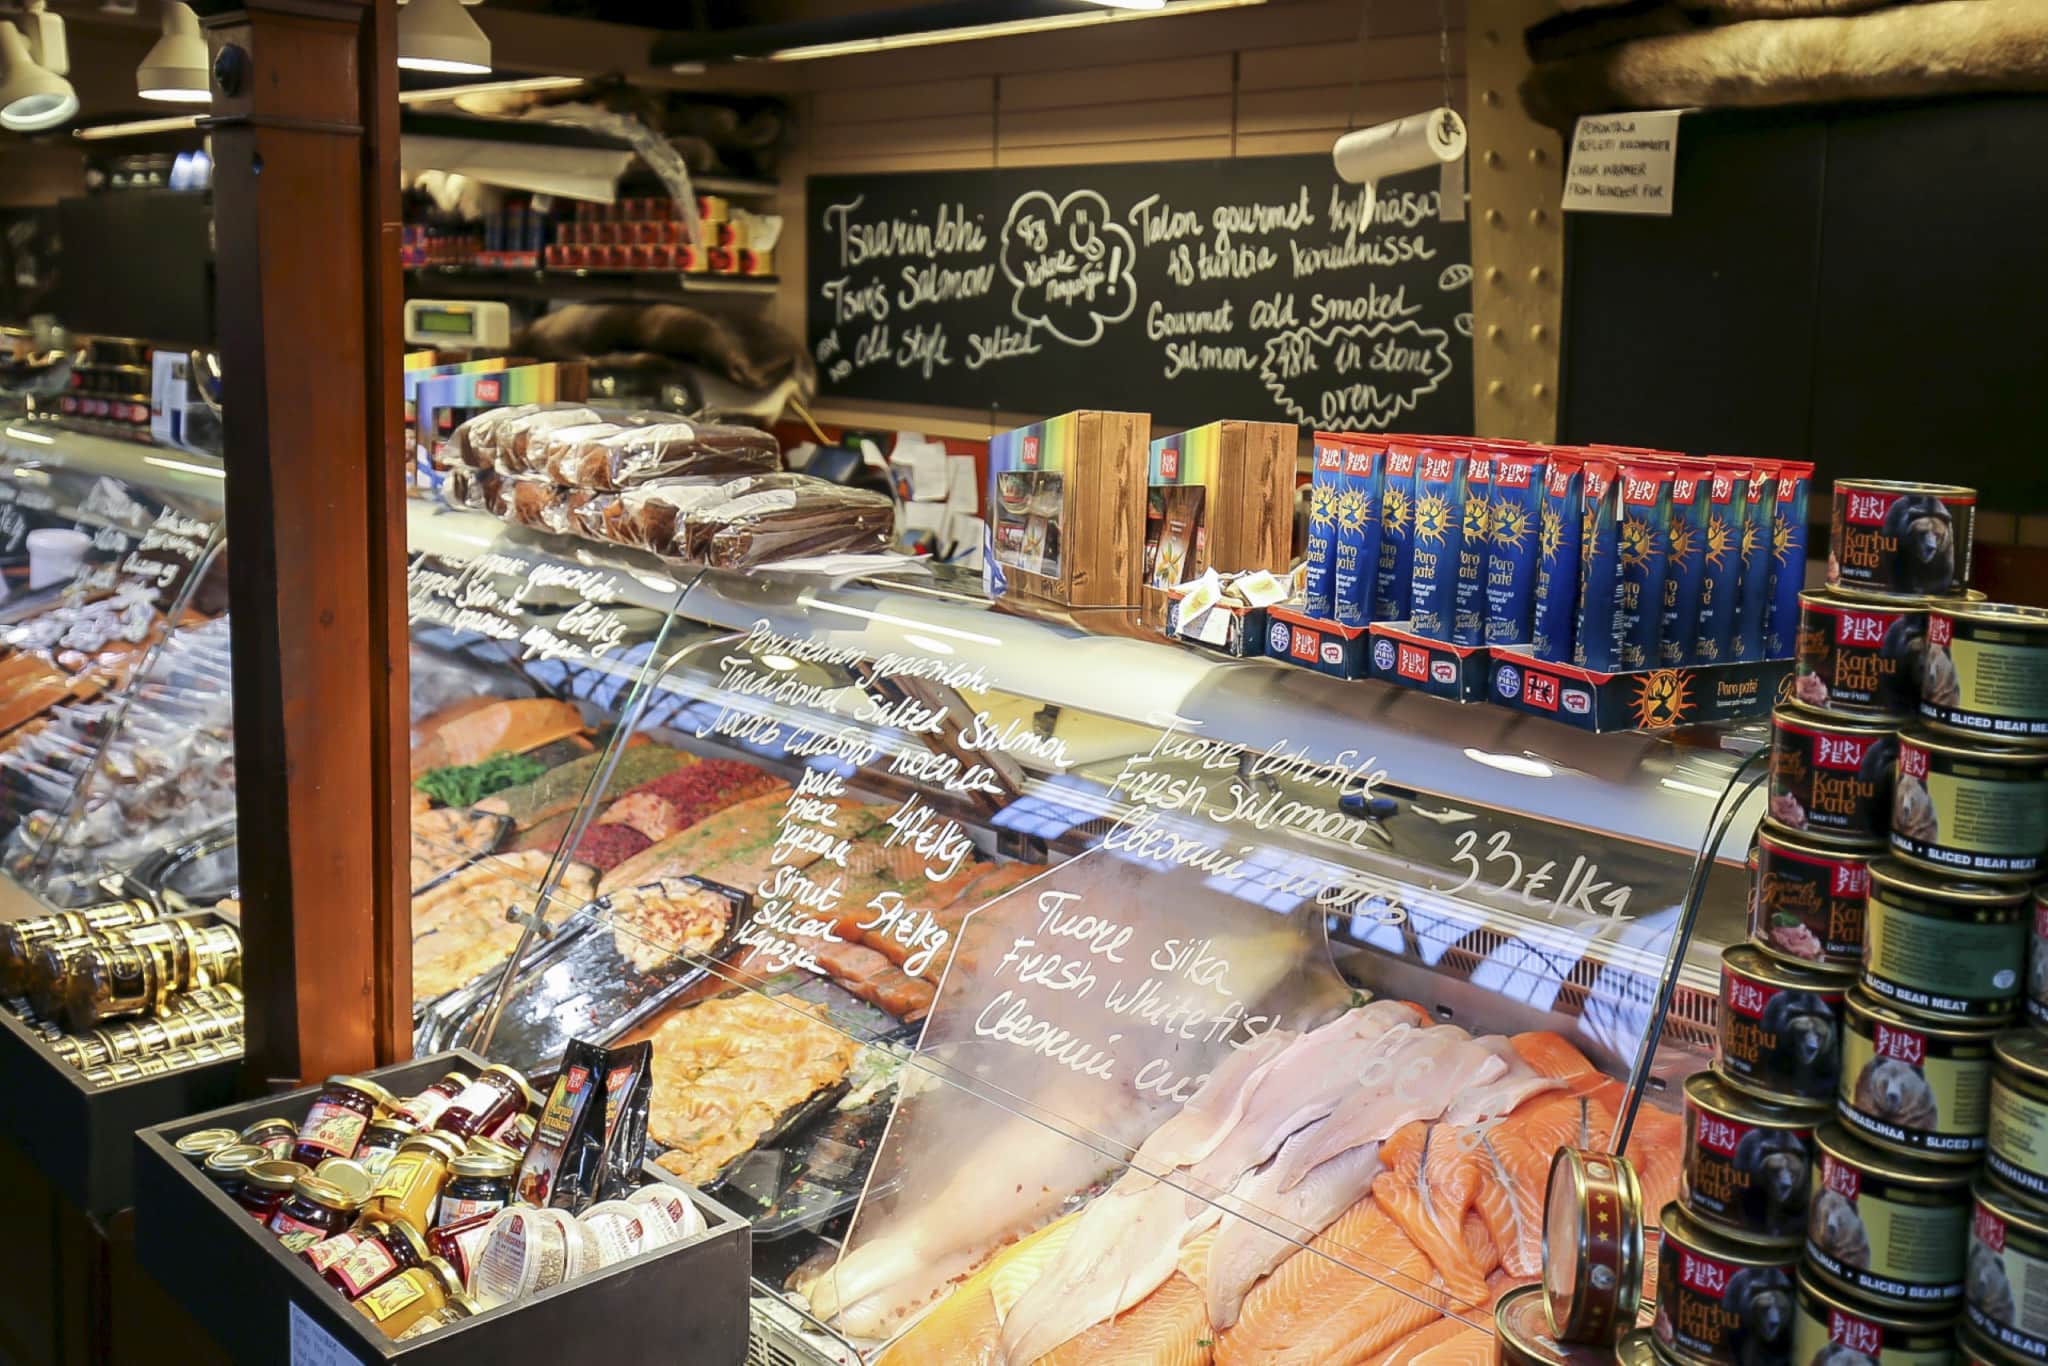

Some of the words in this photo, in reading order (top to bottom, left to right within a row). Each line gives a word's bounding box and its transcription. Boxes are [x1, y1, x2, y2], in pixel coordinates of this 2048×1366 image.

[1846, 527, 1898, 552] Karhu
[1835, 648, 1897, 673] Karhu
[854, 694, 946, 735] Salted
[957, 712, 1075, 769] Salmon
[1147, 711, 1249, 770] Tuore
[1950, 713, 1991, 728] SLICED
[1994, 719, 2028, 732] BEAR
[1105, 753, 1208, 817] Fresh
[1208, 784, 1369, 850] Salmon
[1813, 769, 1875, 797] Karhu
[776, 798, 839, 828] piece
[1928, 847, 1971, 865] SLICED
[1974, 856, 2007, 869] BEAR
[1429, 830, 1637, 938] 33€/kg
[753, 900, 844, 943] Sliced
[1037, 890, 1136, 964] Tuore
[993, 935, 1097, 999] Fresh
[1866, 973, 1894, 995] SLICED
[1896, 989, 1929, 1005] BEAR
[1932, 997, 1968, 1013] MEAT
[1858, 1273, 1906, 1296] SLICED
